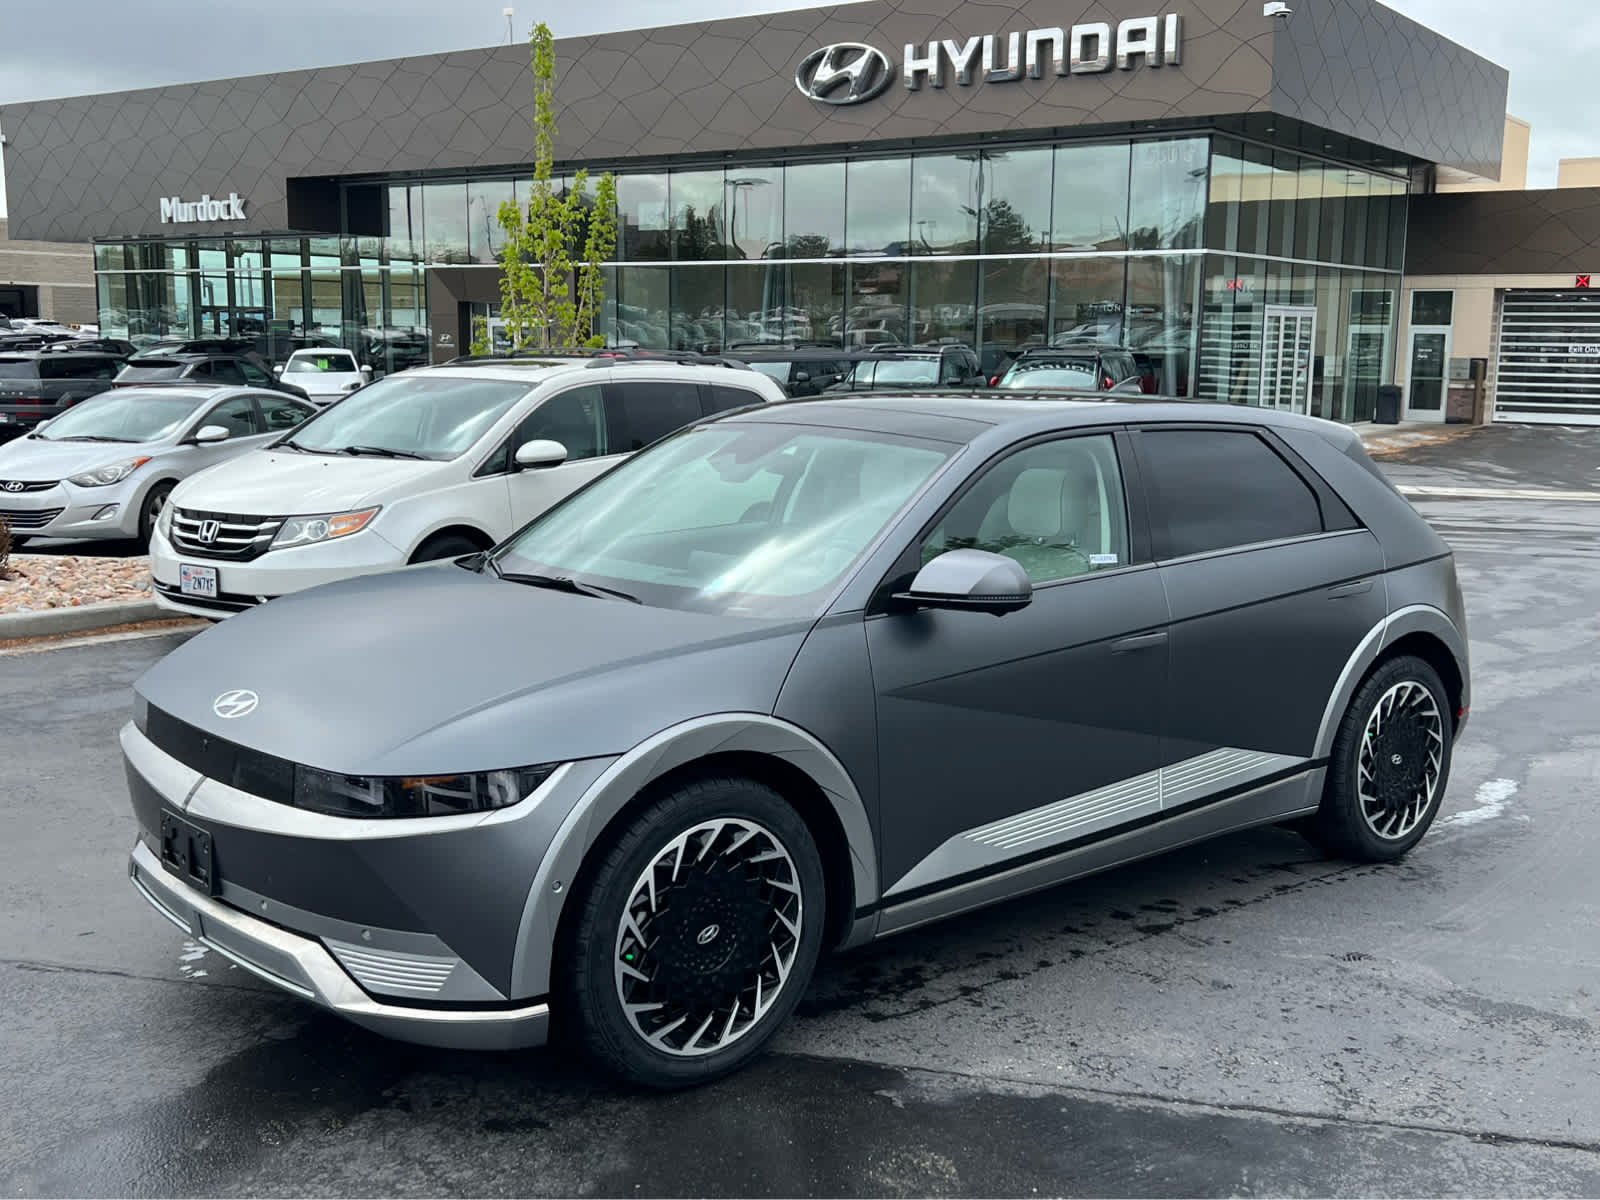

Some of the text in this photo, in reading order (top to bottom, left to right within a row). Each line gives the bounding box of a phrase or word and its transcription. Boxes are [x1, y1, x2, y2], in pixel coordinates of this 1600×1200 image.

[903, 13, 1184, 91] HYUNDAI
[160, 192, 246, 224] Murdock
[1568, 343, 1582, 353] Exit
